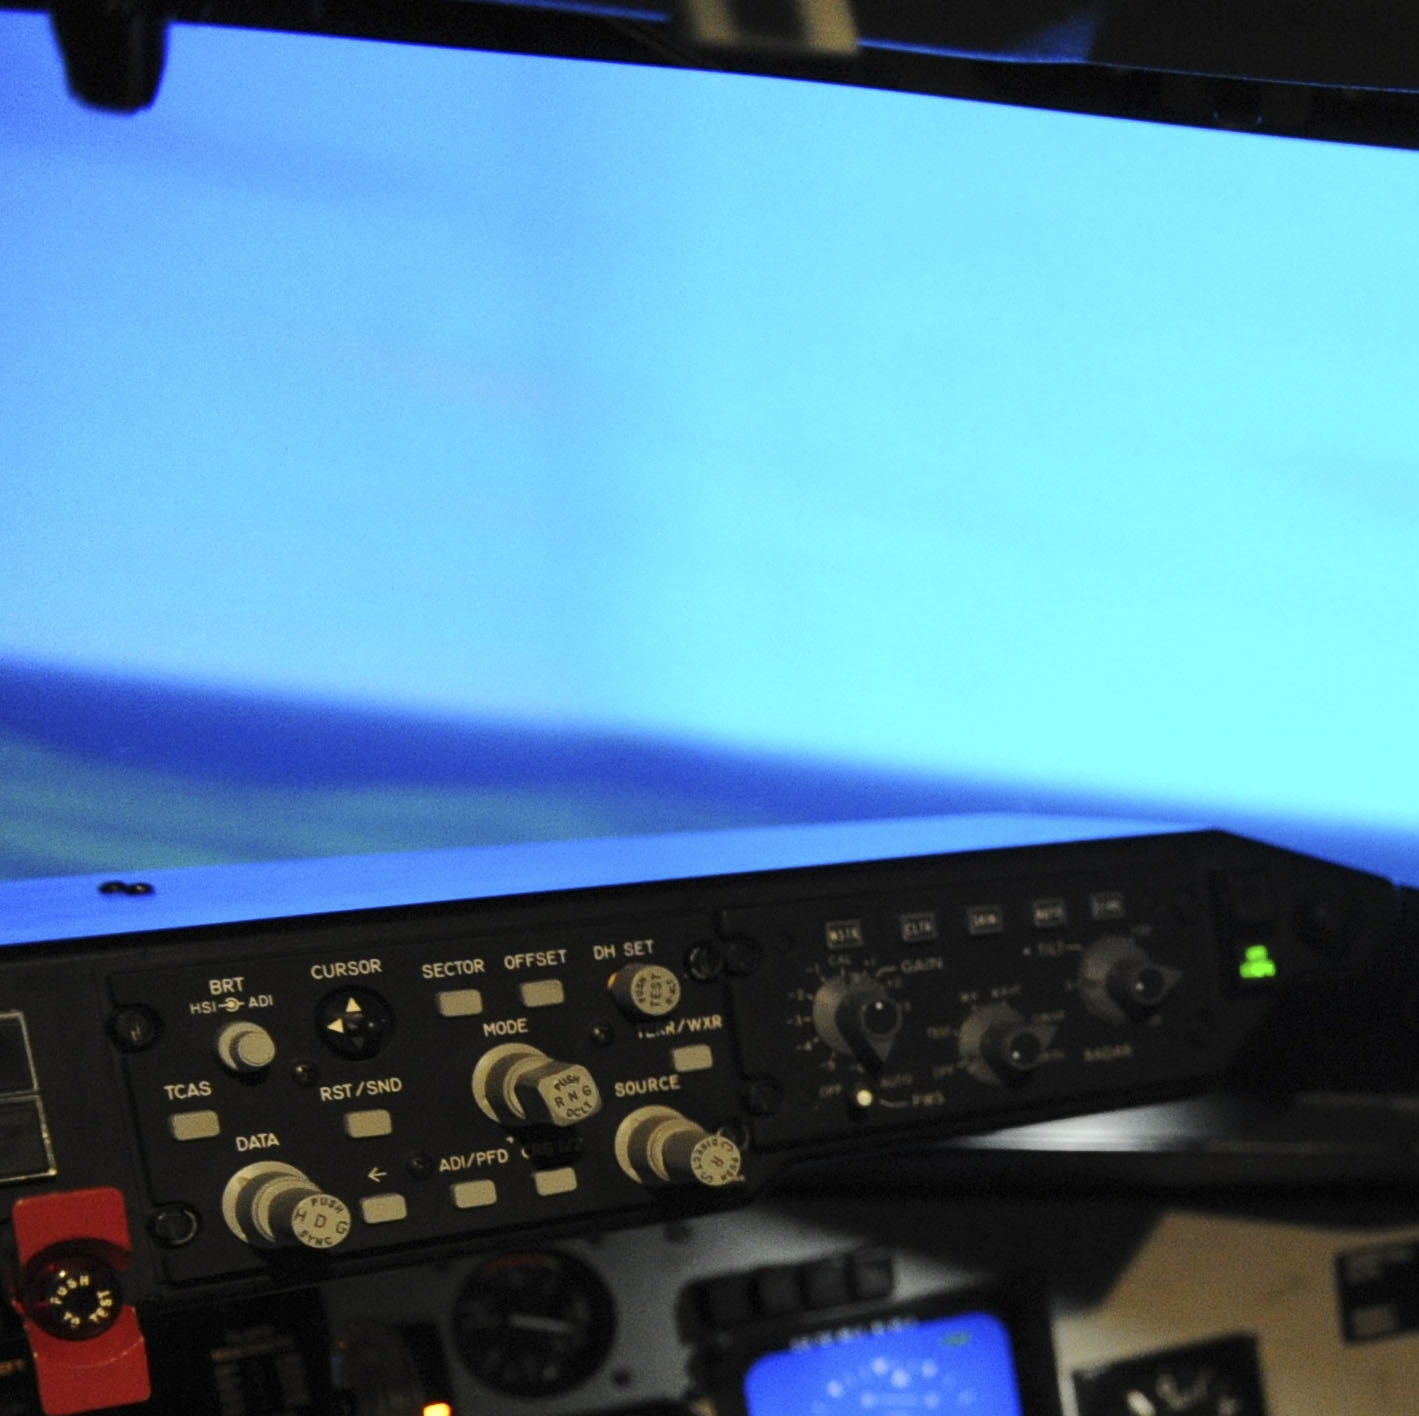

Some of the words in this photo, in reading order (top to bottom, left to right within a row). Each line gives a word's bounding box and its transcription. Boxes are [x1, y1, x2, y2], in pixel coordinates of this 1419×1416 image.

[503, 949, 568, 971] OFFSET
[593, 944, 616, 961] DH
[624, 939, 655, 957] SET
[310, 958, 383, 980] CURSOR
[421, 958, 485, 979] SECTOR
[208, 976, 245, 996] BRT
[190, 1000, 217, 1015] HSI
[247, 994, 274, 1009] ADI
[483, 1018, 529, 1037] MODE
[164, 1080, 213, 1101] TCAS
[553, 1074, 581, 1092] PUSH
[614, 1074, 681, 1097] SOURCE
[235, 1132, 280, 1152] DATA
[439, 1148, 509, 1172] ADI/PFD
[309, 1197, 345, 1214] PUSH
[299, 1229, 333, 1247] SYNC
